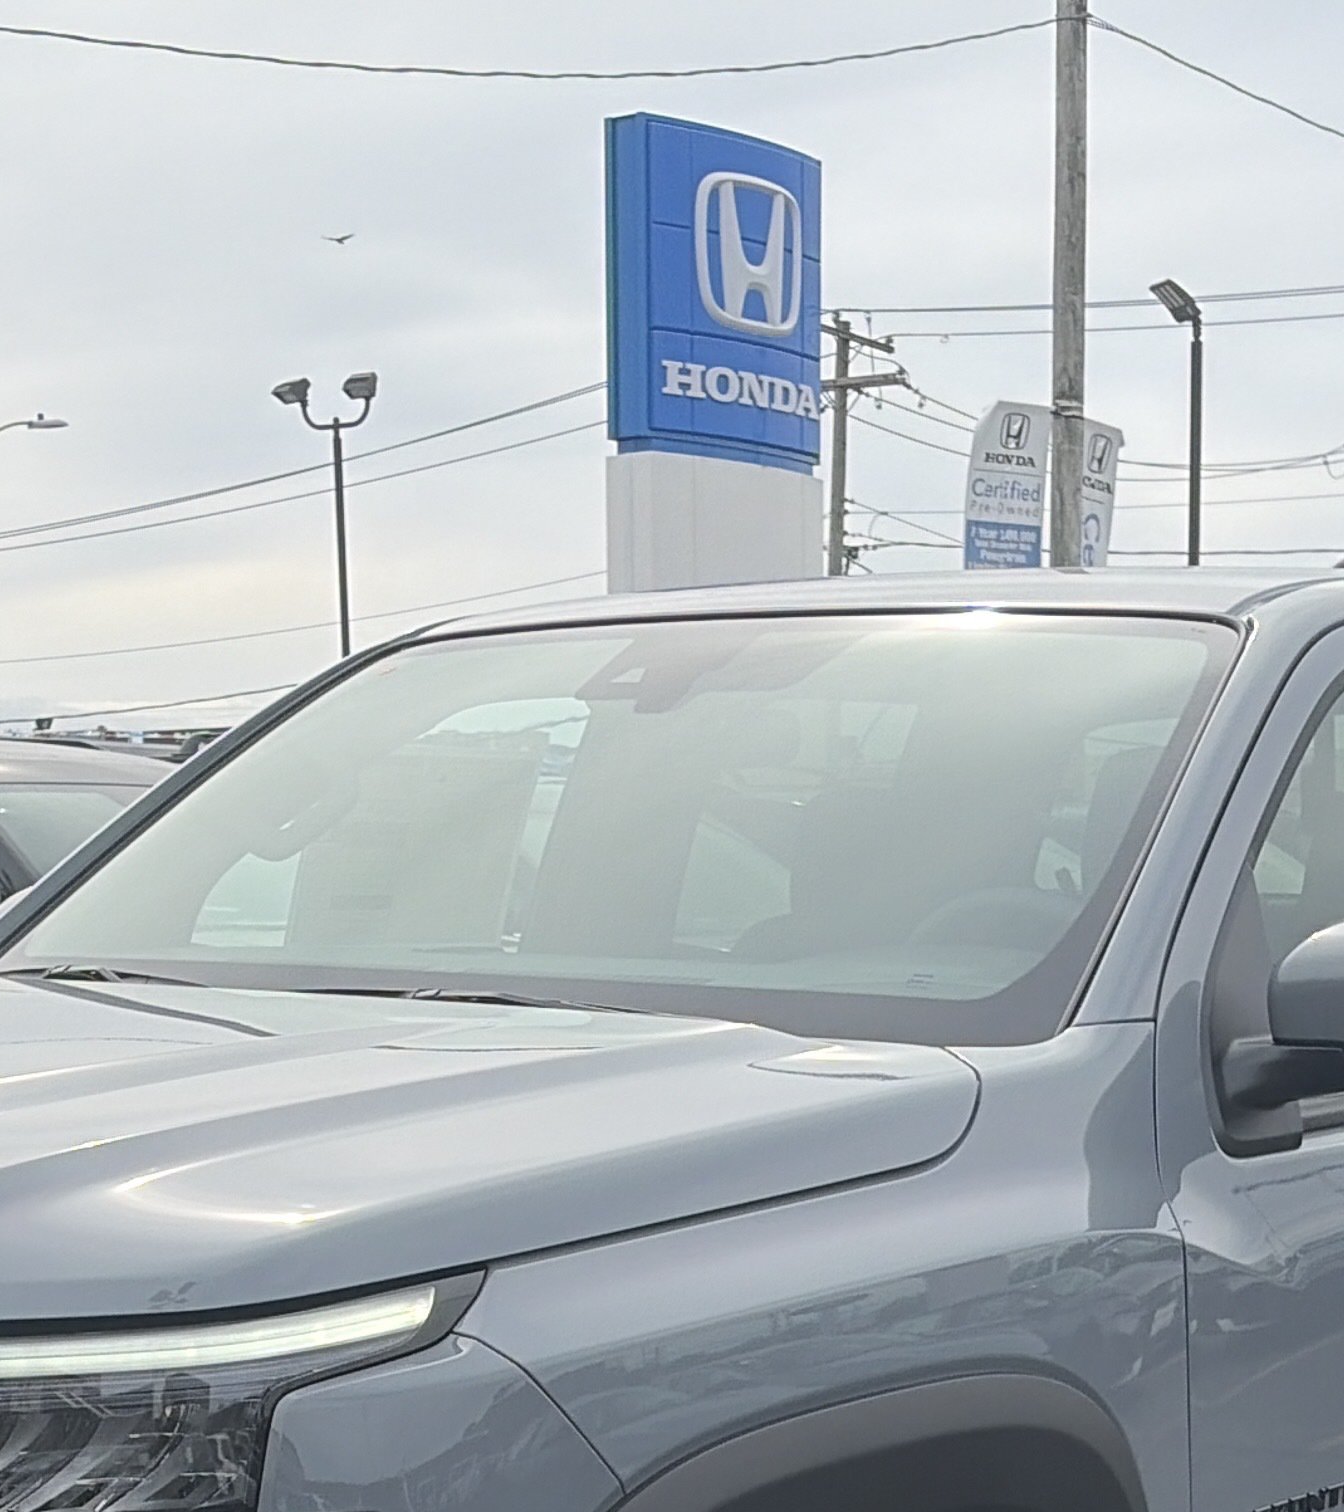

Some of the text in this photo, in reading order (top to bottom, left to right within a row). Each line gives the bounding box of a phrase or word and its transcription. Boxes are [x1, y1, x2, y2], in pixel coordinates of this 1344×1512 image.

[661, 360, 820, 420] HONDA
[984, 452, 1036, 468] HONDA
[971, 478, 1041, 502] Certified
